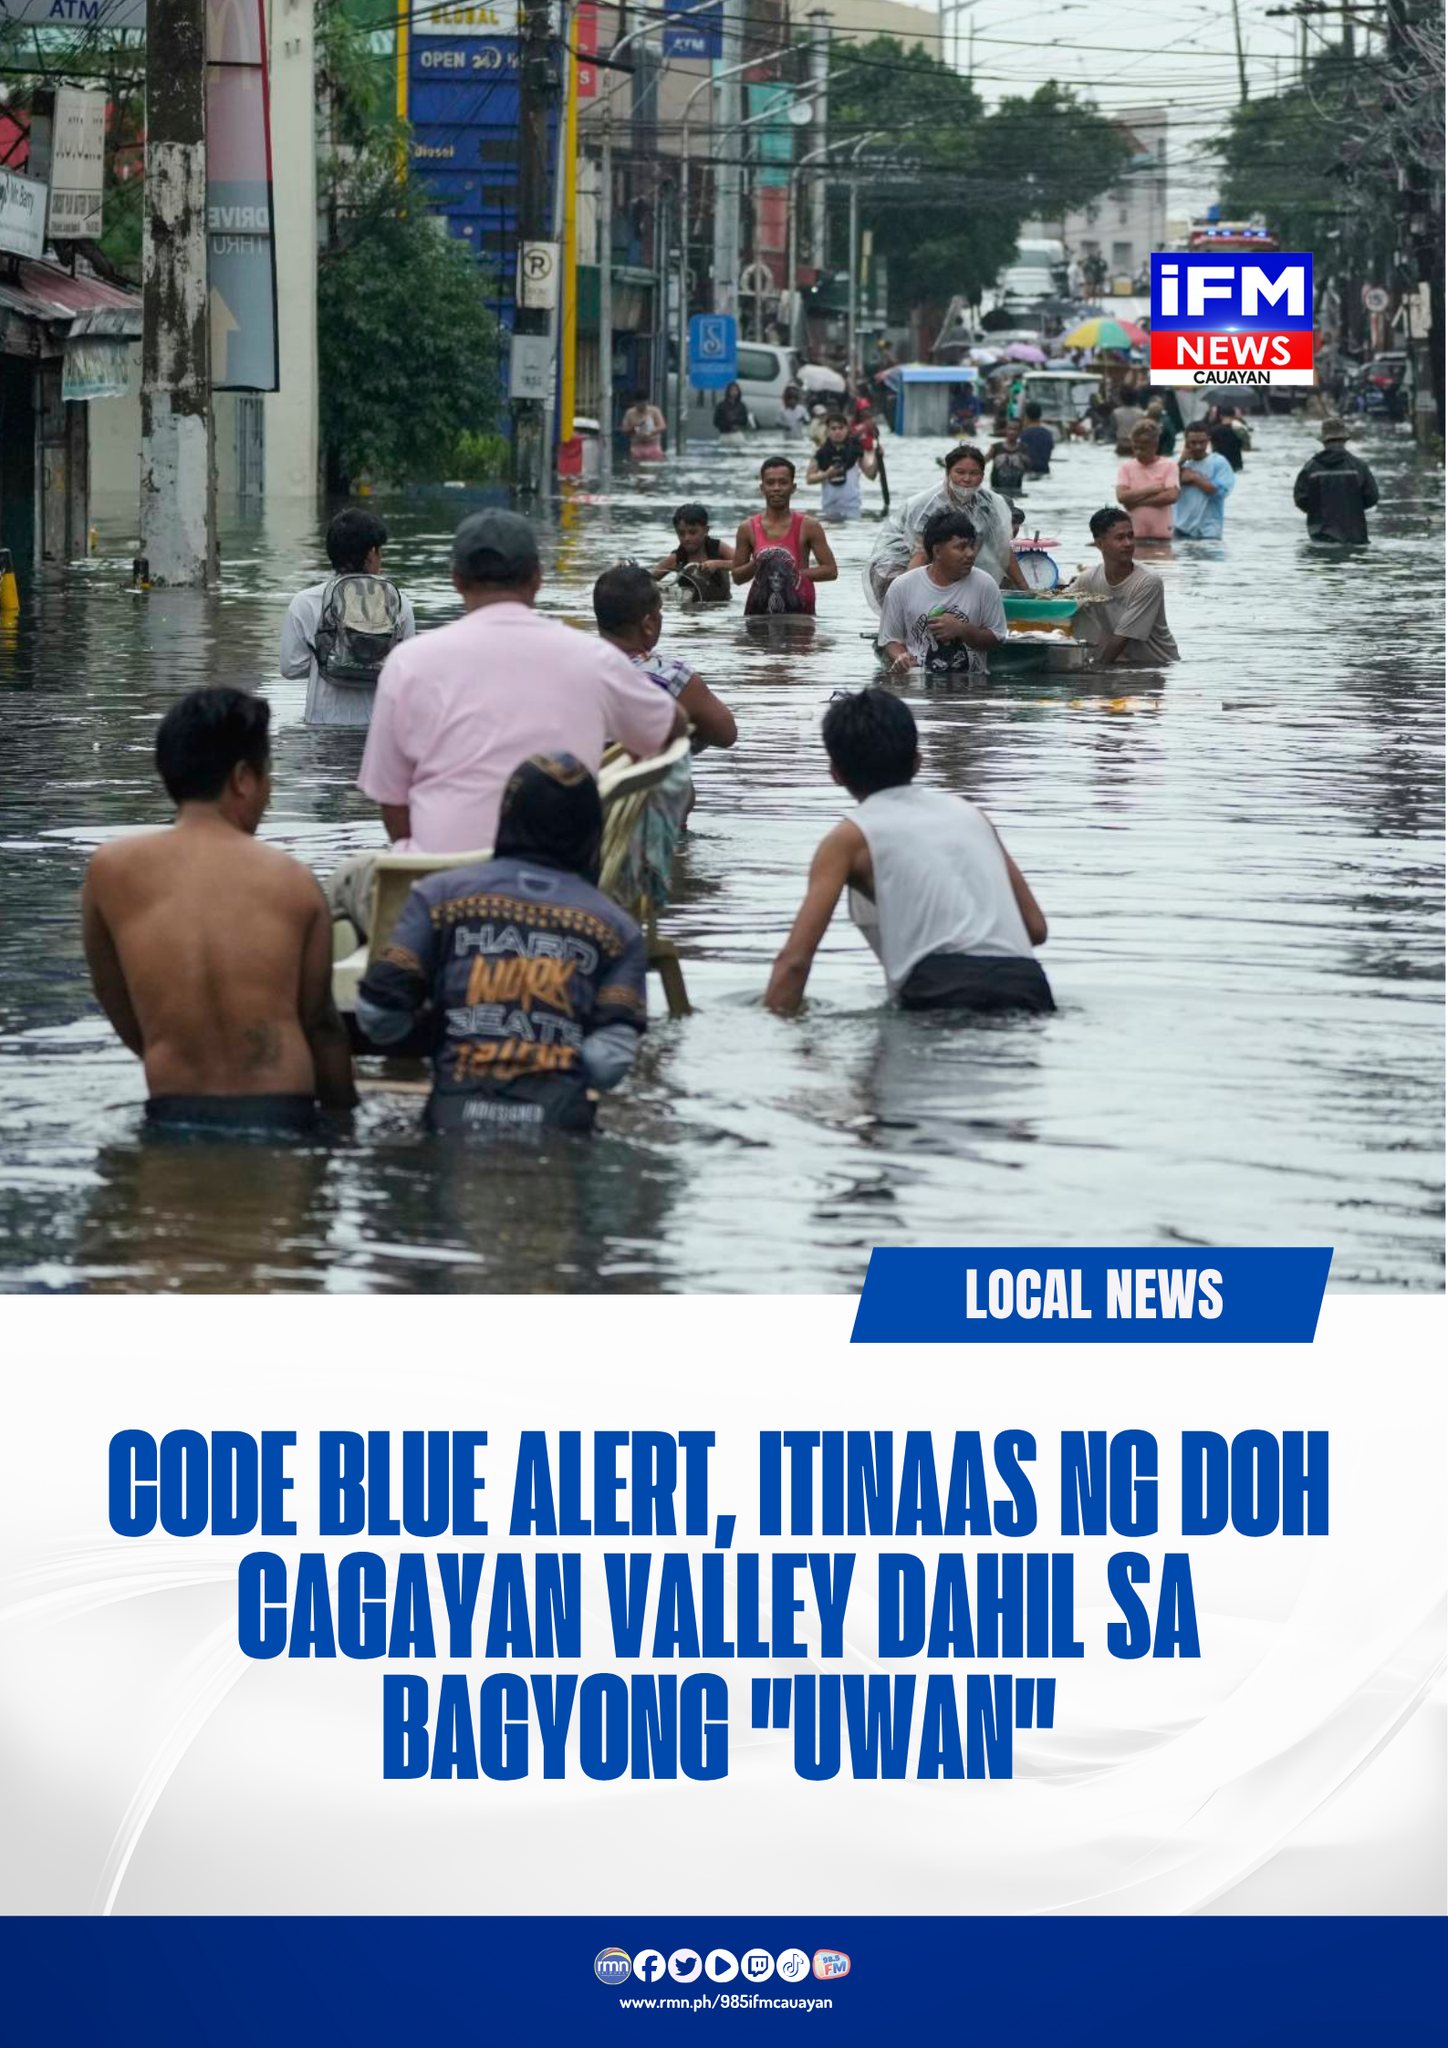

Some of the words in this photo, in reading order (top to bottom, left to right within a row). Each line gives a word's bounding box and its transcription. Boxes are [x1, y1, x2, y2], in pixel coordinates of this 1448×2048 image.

[49, 0, 98, 19] ATM
[673, 37, 705, 52] ATM
[420, 50, 466, 68] OPEN
[414, 142, 455, 159] Diesel
[454, 922, 600, 976] HARD
[465, 953, 576, 1018] WORK
[444, 1003, 584, 1047] BEATS
